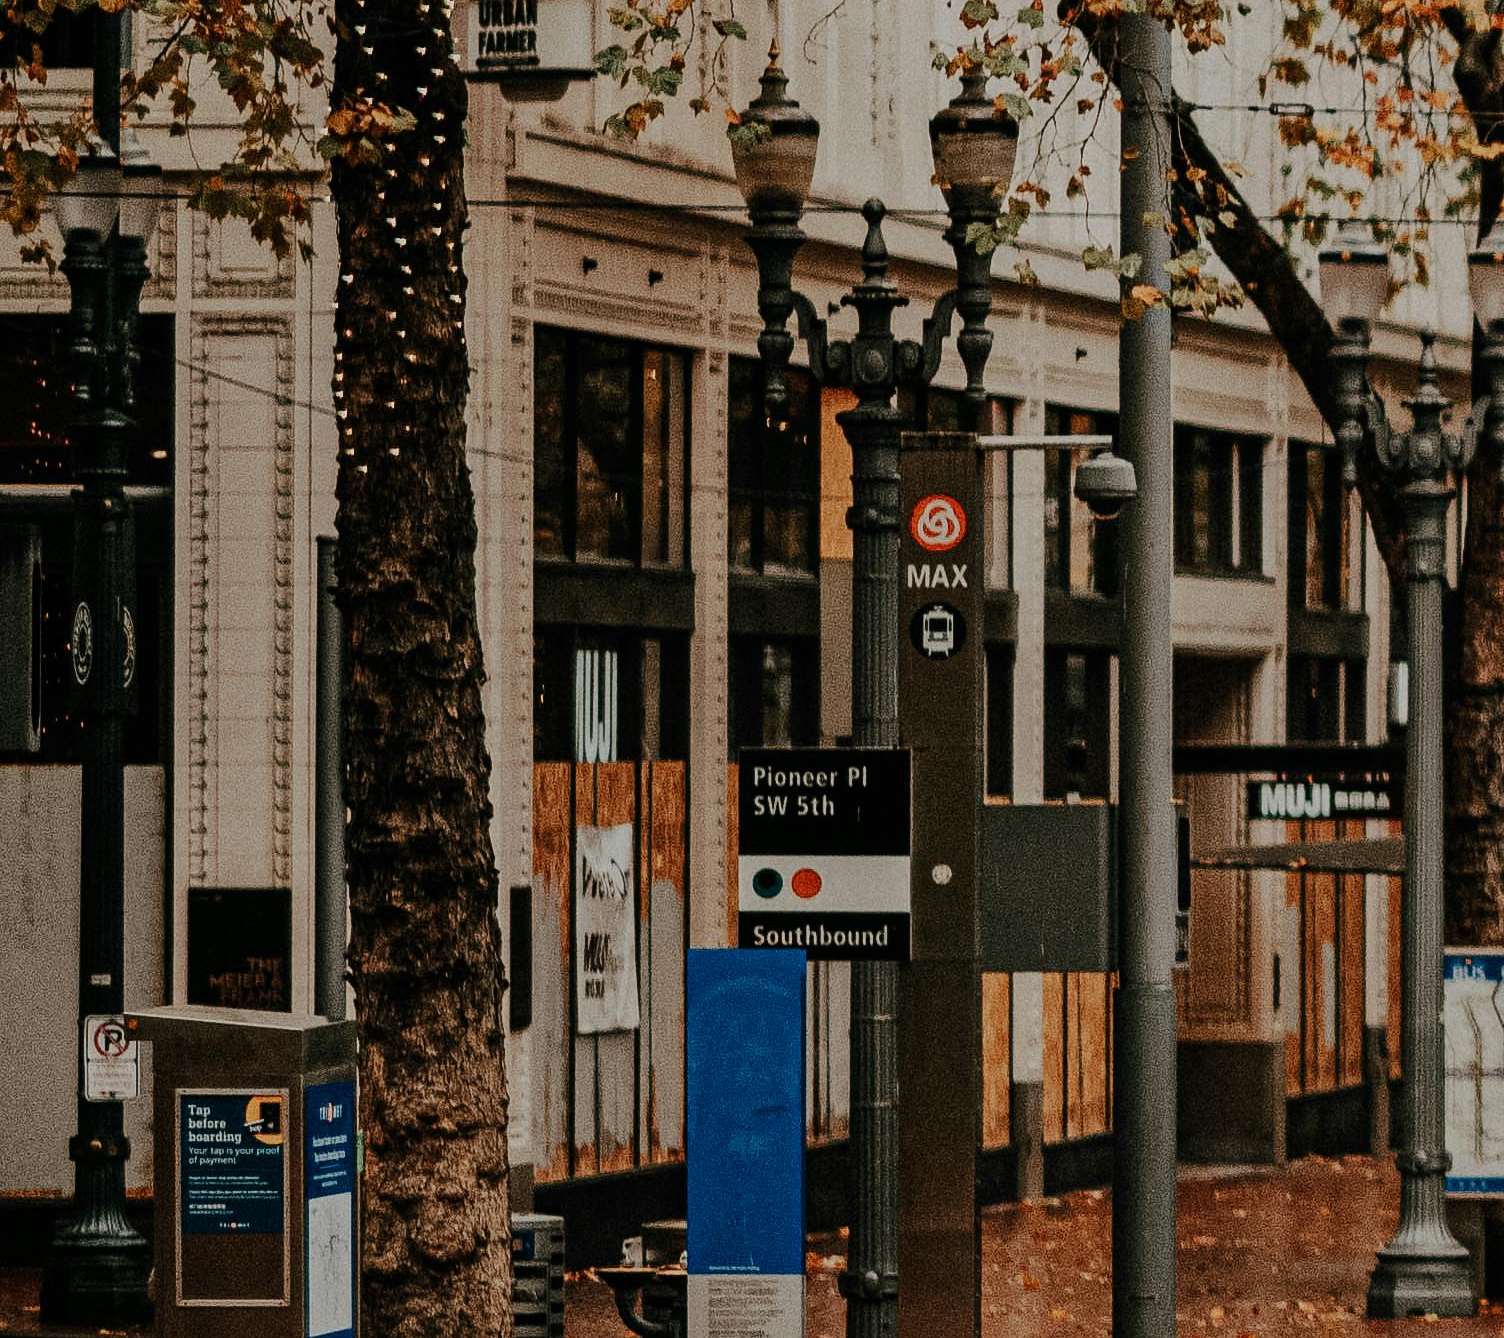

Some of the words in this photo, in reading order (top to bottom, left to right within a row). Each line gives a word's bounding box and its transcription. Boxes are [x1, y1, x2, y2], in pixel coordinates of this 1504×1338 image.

[479, 29, 538, 52] FARMER
[906, 564, 968, 589] MAX
[753, 765, 838, 787] Pioneer
[848, 765, 867, 788] Pl
[753, 795, 788, 817] SW
[797, 794, 835, 817] 5th
[1261, 782, 1331, 818] MUJI
[753, 924, 888, 947] Southbound
[187, 1104, 211, 1117] Tap
[188, 1118, 227, 1129] before
[188, 1130, 242, 1144] boarding
[188, 1147, 208, 1156] Your
[210, 1147, 225, 1157] tap
[226, 1147, 234, 1155] is
[234, 1148, 254, 1157] your
[256, 1146, 280, 1157] proof
[188, 1156, 198, 1165] of
[199, 1156, 237, 1166] payment
